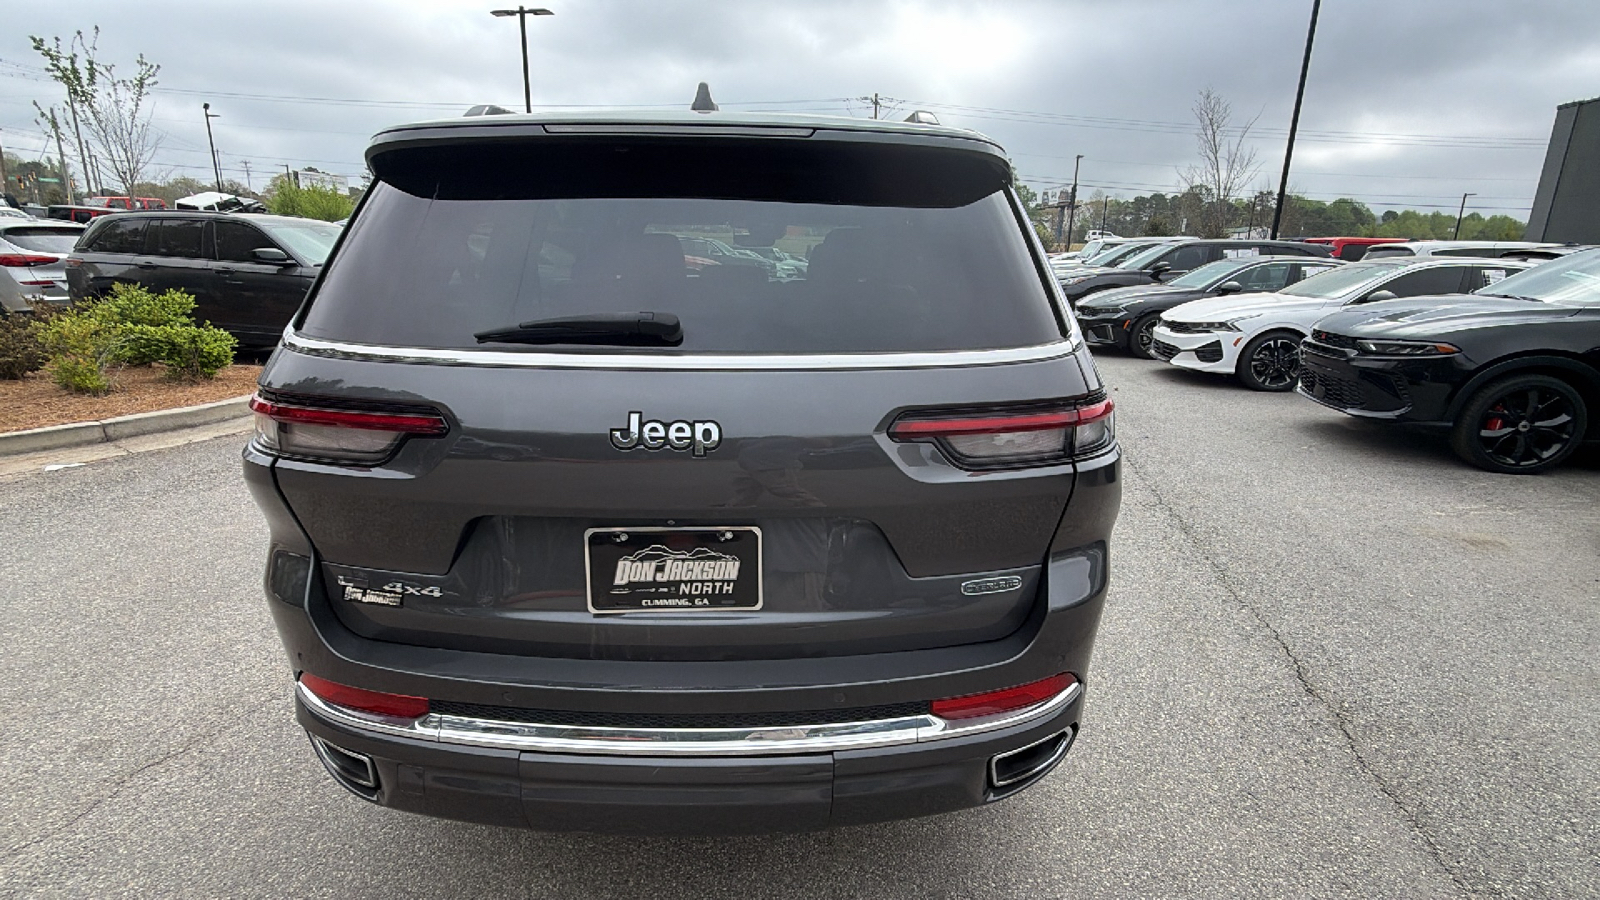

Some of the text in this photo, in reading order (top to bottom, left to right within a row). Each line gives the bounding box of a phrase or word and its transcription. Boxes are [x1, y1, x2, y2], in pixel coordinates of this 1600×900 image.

[610, 411, 722, 457] Jeep
[655, 559, 741, 583] JACKSON
[679, 582, 734, 596] NORTH
[695, 598, 710, 606] GA
